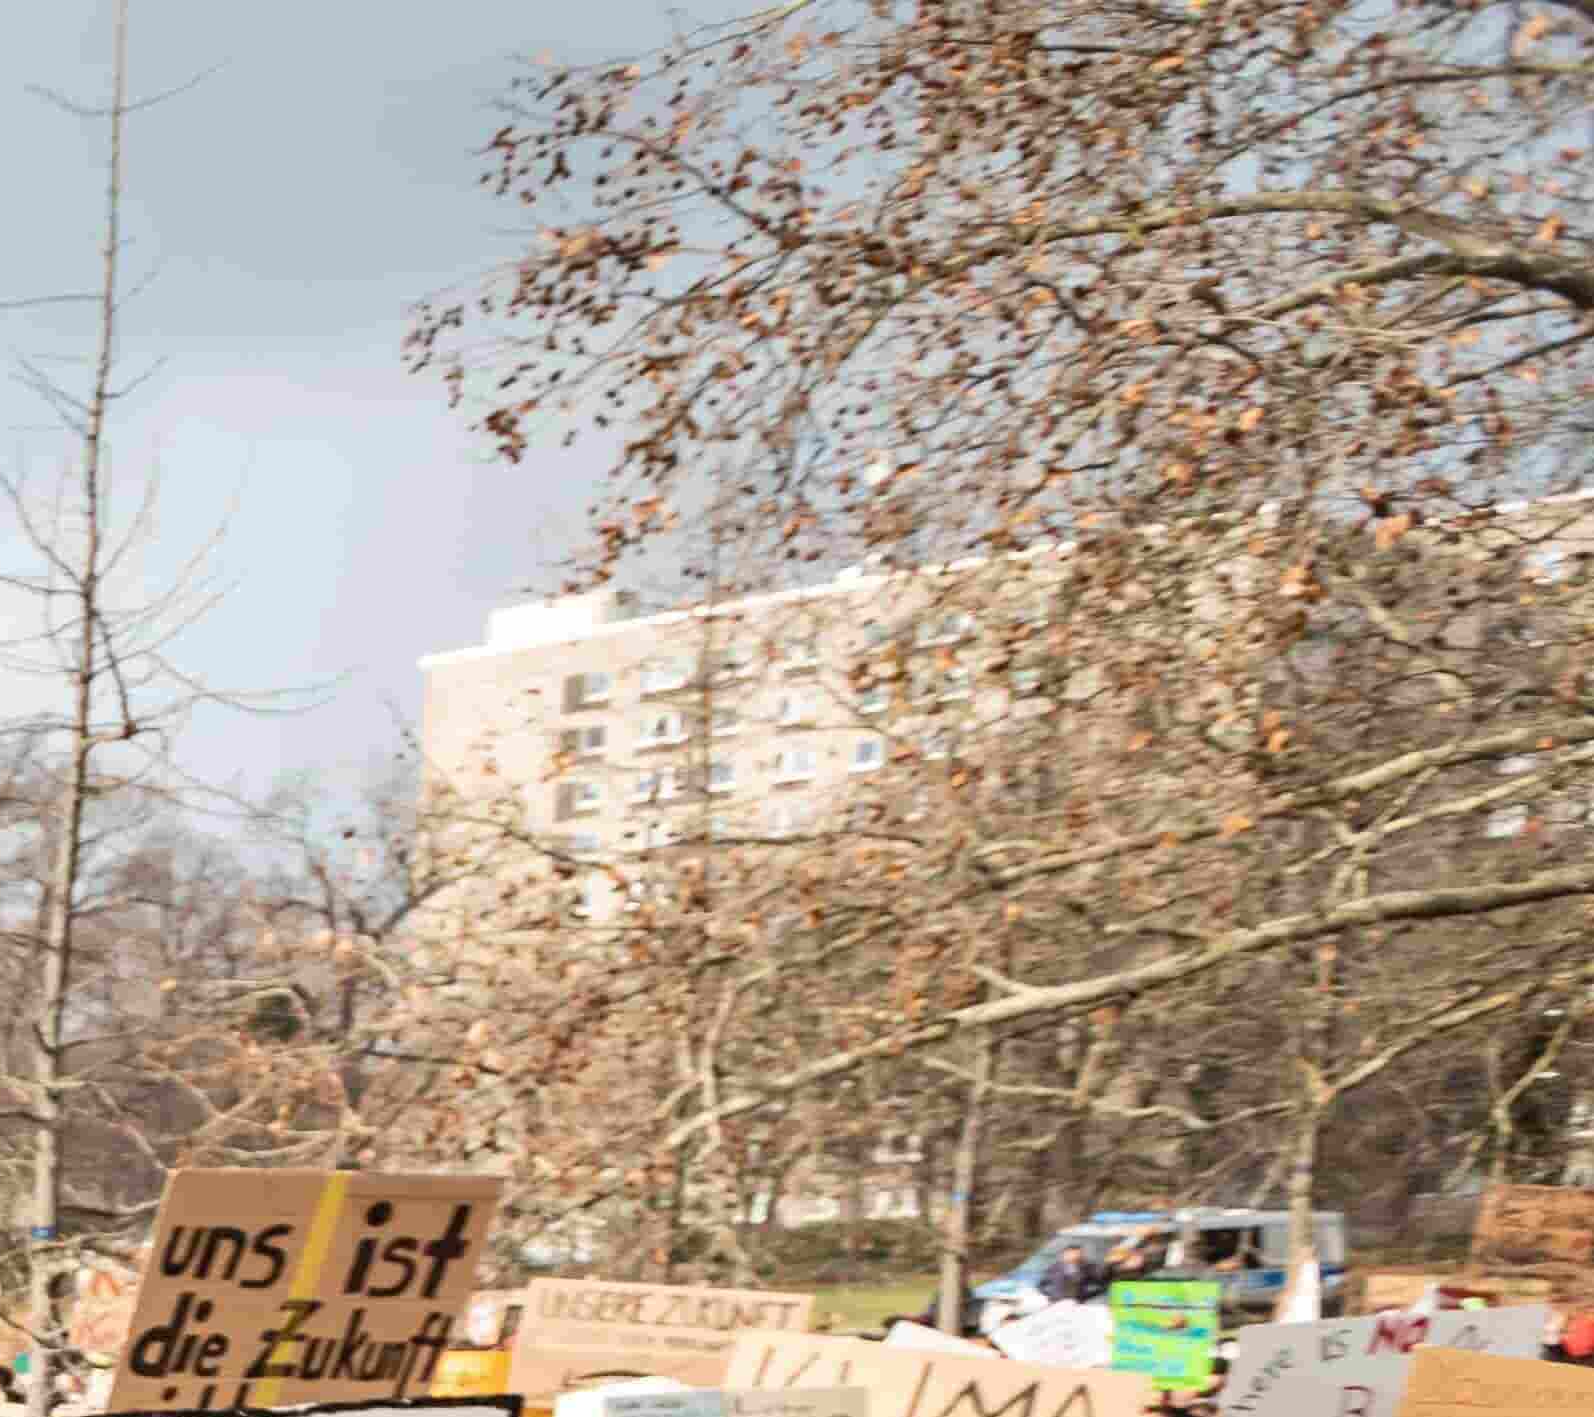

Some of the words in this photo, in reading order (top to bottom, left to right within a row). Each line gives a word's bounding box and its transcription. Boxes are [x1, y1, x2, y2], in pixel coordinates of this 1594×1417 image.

[160, 1222, 286, 1292] uns
[345, 1200, 472, 1298] ist
[130, 1293, 230, 1381] die
[253, 1297, 453, 1386] Zukunft
